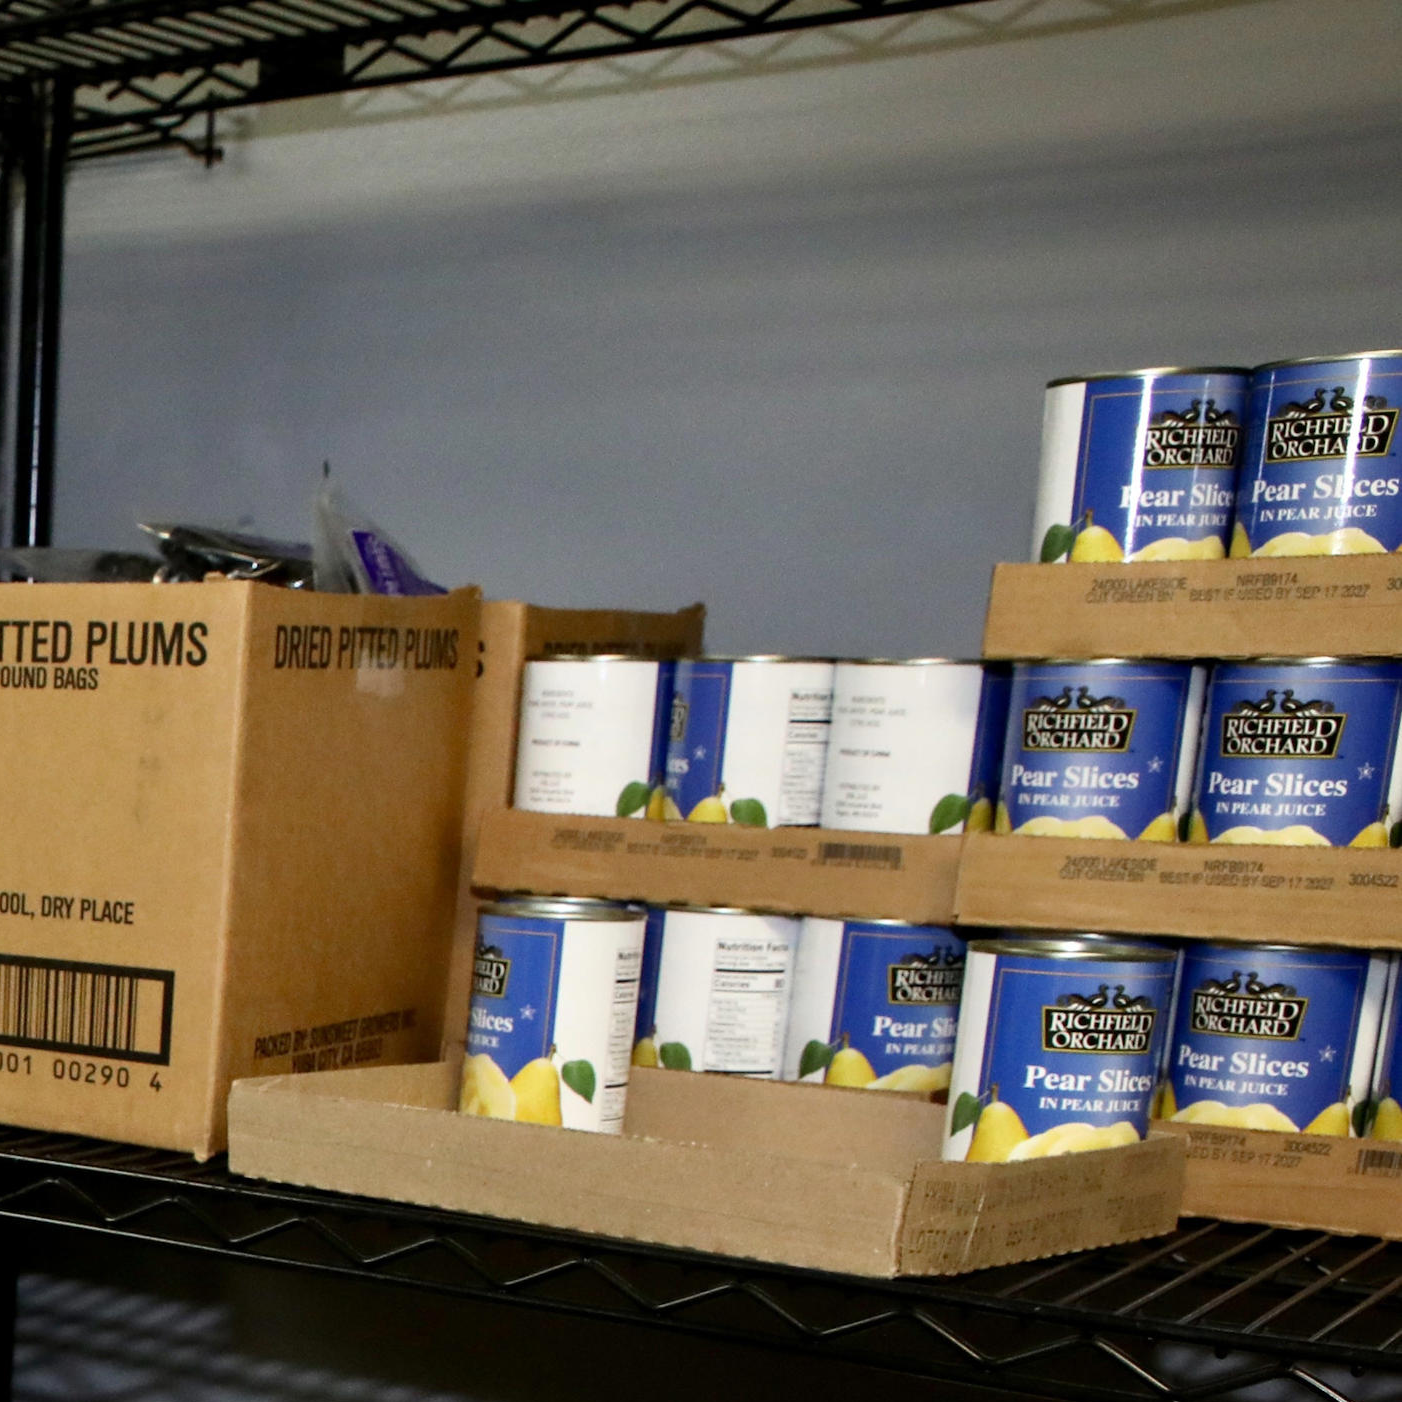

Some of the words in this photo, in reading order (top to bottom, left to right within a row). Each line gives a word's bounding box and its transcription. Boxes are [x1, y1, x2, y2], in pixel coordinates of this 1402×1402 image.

[1146, 427, 1238, 452] RICHFIELD
[1271, 414, 1390, 443] RICHFIED
[1146, 445, 1234, 467] ORCHARD
[1271, 435, 1380, 459] ORCHAD
[1190, 483, 1232, 509] Slice
[1252, 479, 1307, 503] Pear
[1312, 473, 1400, 500] Slces
[1156, 513, 1194, 528] PEAR
[1260, 509, 1275, 523] IN
[1276, 507, 1320, 521] PEAR
[86, 621, 209, 667] PLUMS
[274, 624, 333, 670] DRIED
[337, 626, 399, 671] PITTED
[403, 628, 460, 671] PLUMS
[53, 667, 98, 691] BAGS
[1026, 714, 1128, 734] RICHFIELD
[1227, 717, 1337, 741] RICHFIELD
[1026, 729, 1120, 749] ORCHARD
[1226, 734, 1328, 755] ORCHARD
[1011, 764, 1060, 788] Pear
[1065, 765, 1140, 790] Slices
[1208, 771, 1259, 795] Pear
[1264, 771, 1348, 798] Slices
[1018, 792, 1031, 806] IN
[1032, 793, 1070, 807] PEAR
[1073, 794, 1121, 808] JUICE
[1216, 802, 1229, 815] IN
[1230, 802, 1272, 816] PEAR
[1274, 802, 1327, 817] JUICE
[41, 895, 75, 919] DRY
[80, 898, 135, 925] PLACE
[1195, 994, 1299, 1022] RICHFIELD
[873, 1015, 928, 1038] Pear
[1049, 1011, 1152, 1034] RICHFIELD
[1195, 1013, 1291, 1037] ORCHARD
[886, 1042, 901, 1055] IN
[902, 1043, 935, 1055] PEAR
[1051, 1031, 1146, 1051] ORCHARD
[1177, 1042, 1224, 1072] Pear
[1229, 1050, 1310, 1079] Slices
[52, 1058, 131, 1089] 00290
[148, 1070, 164, 1093] 4
[1024, 1065, 1092, 1093] Pear
[1097, 1069, 1153, 1093] Slices
[1184, 1073, 1196, 1086] IN
[1197, 1075, 1235, 1094] PEAR
[1237, 1080, 1289, 1096] JUICE
[1039, 1096, 1057, 1110] IN
[1060, 1097, 1102, 1112] PEAR
[1103, 1098, 1142, 1113] JUICE
